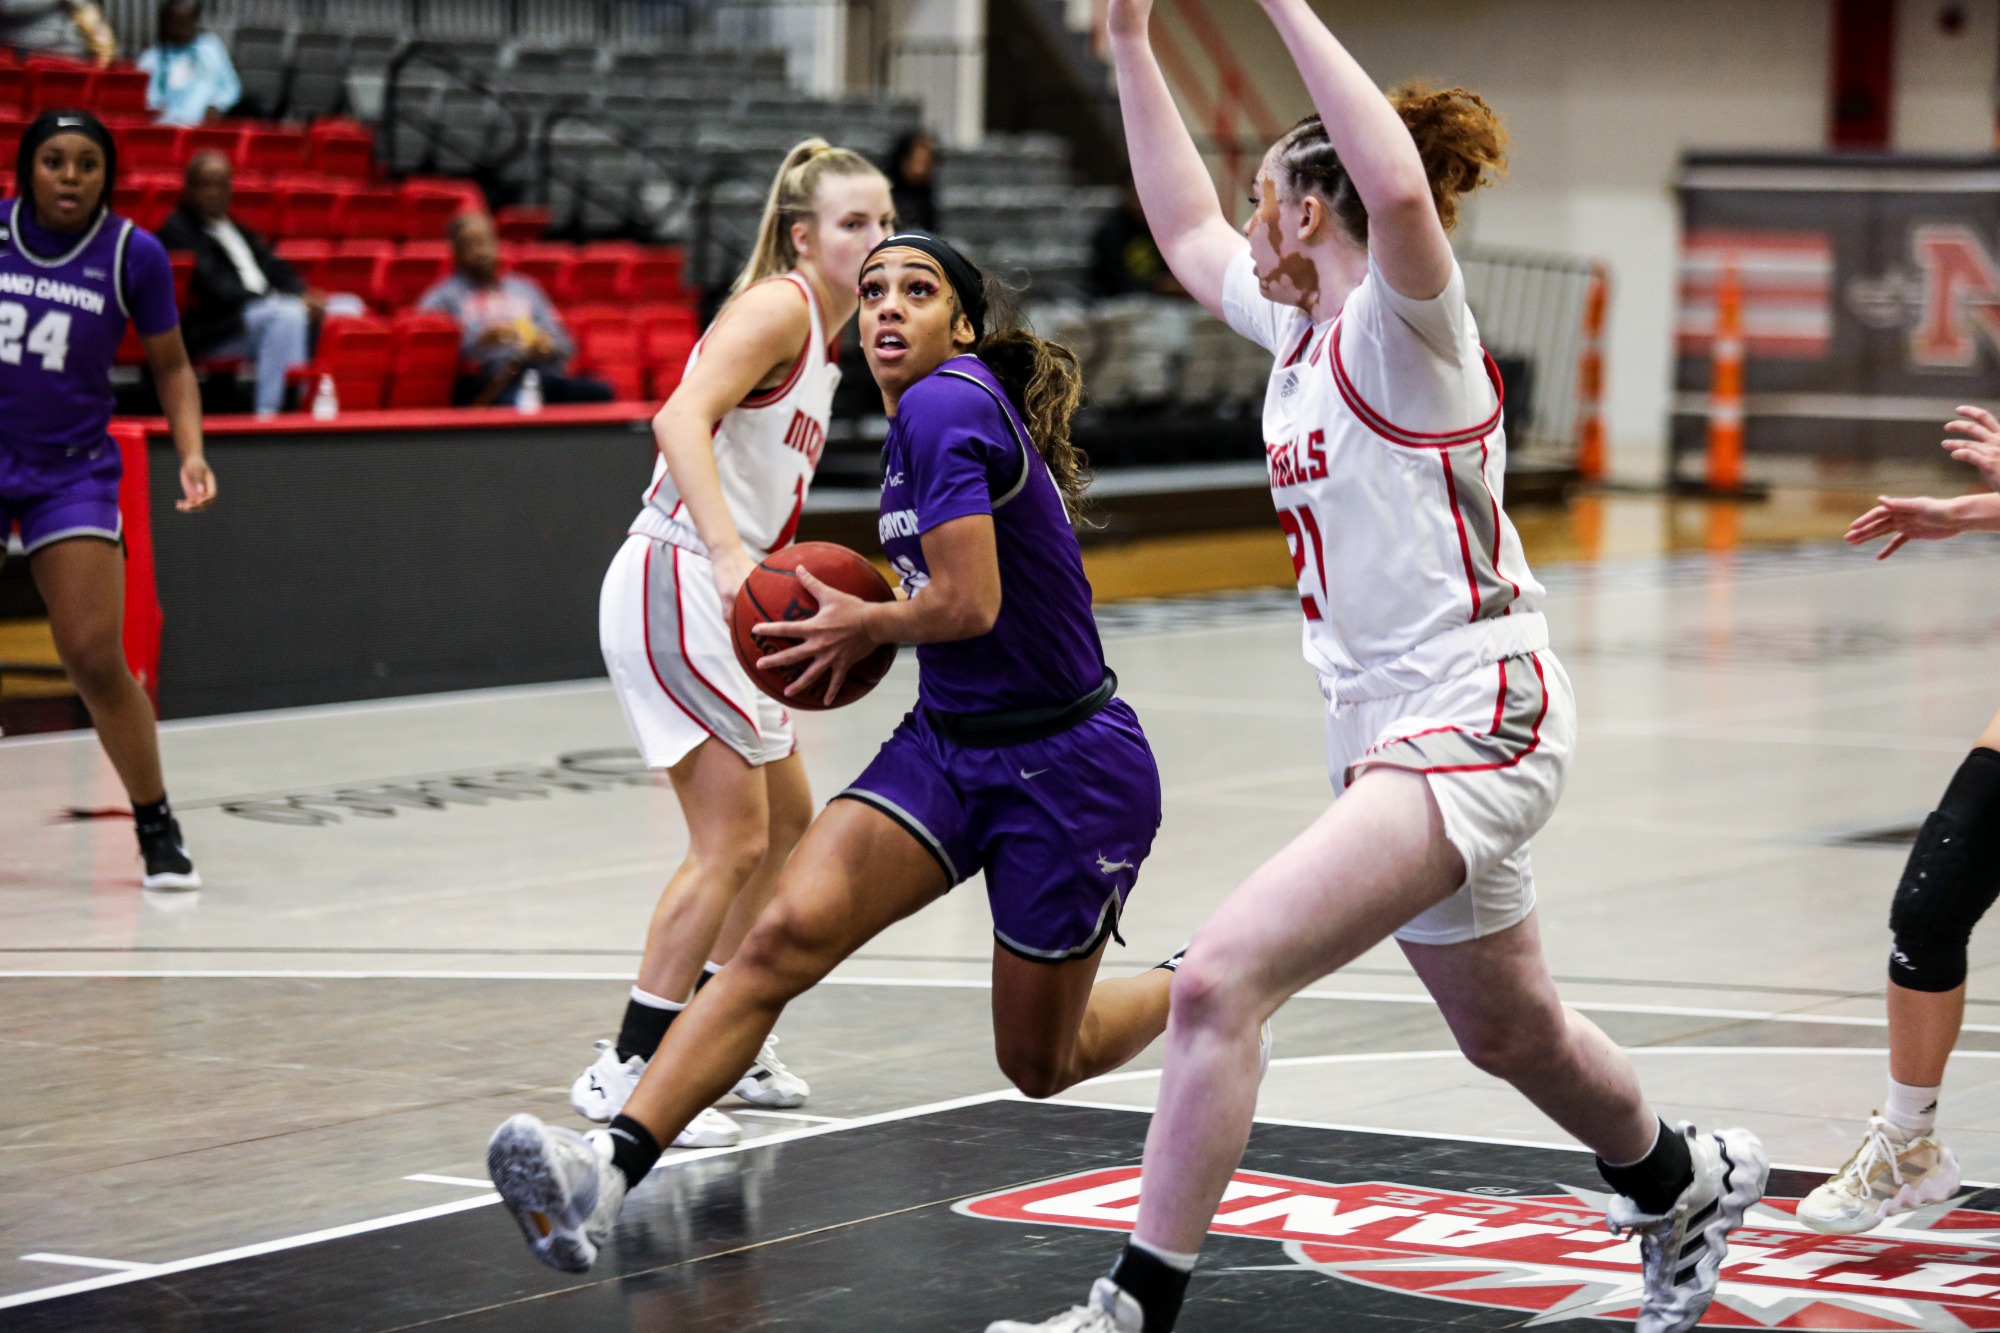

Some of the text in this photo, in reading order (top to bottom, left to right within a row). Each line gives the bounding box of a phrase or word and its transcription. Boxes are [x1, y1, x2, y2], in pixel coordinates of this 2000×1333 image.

[35, 276, 105, 316] CANYON
[0, 301, 72, 373] 24
[1363, 1191, 1994, 1262] FERNCE
